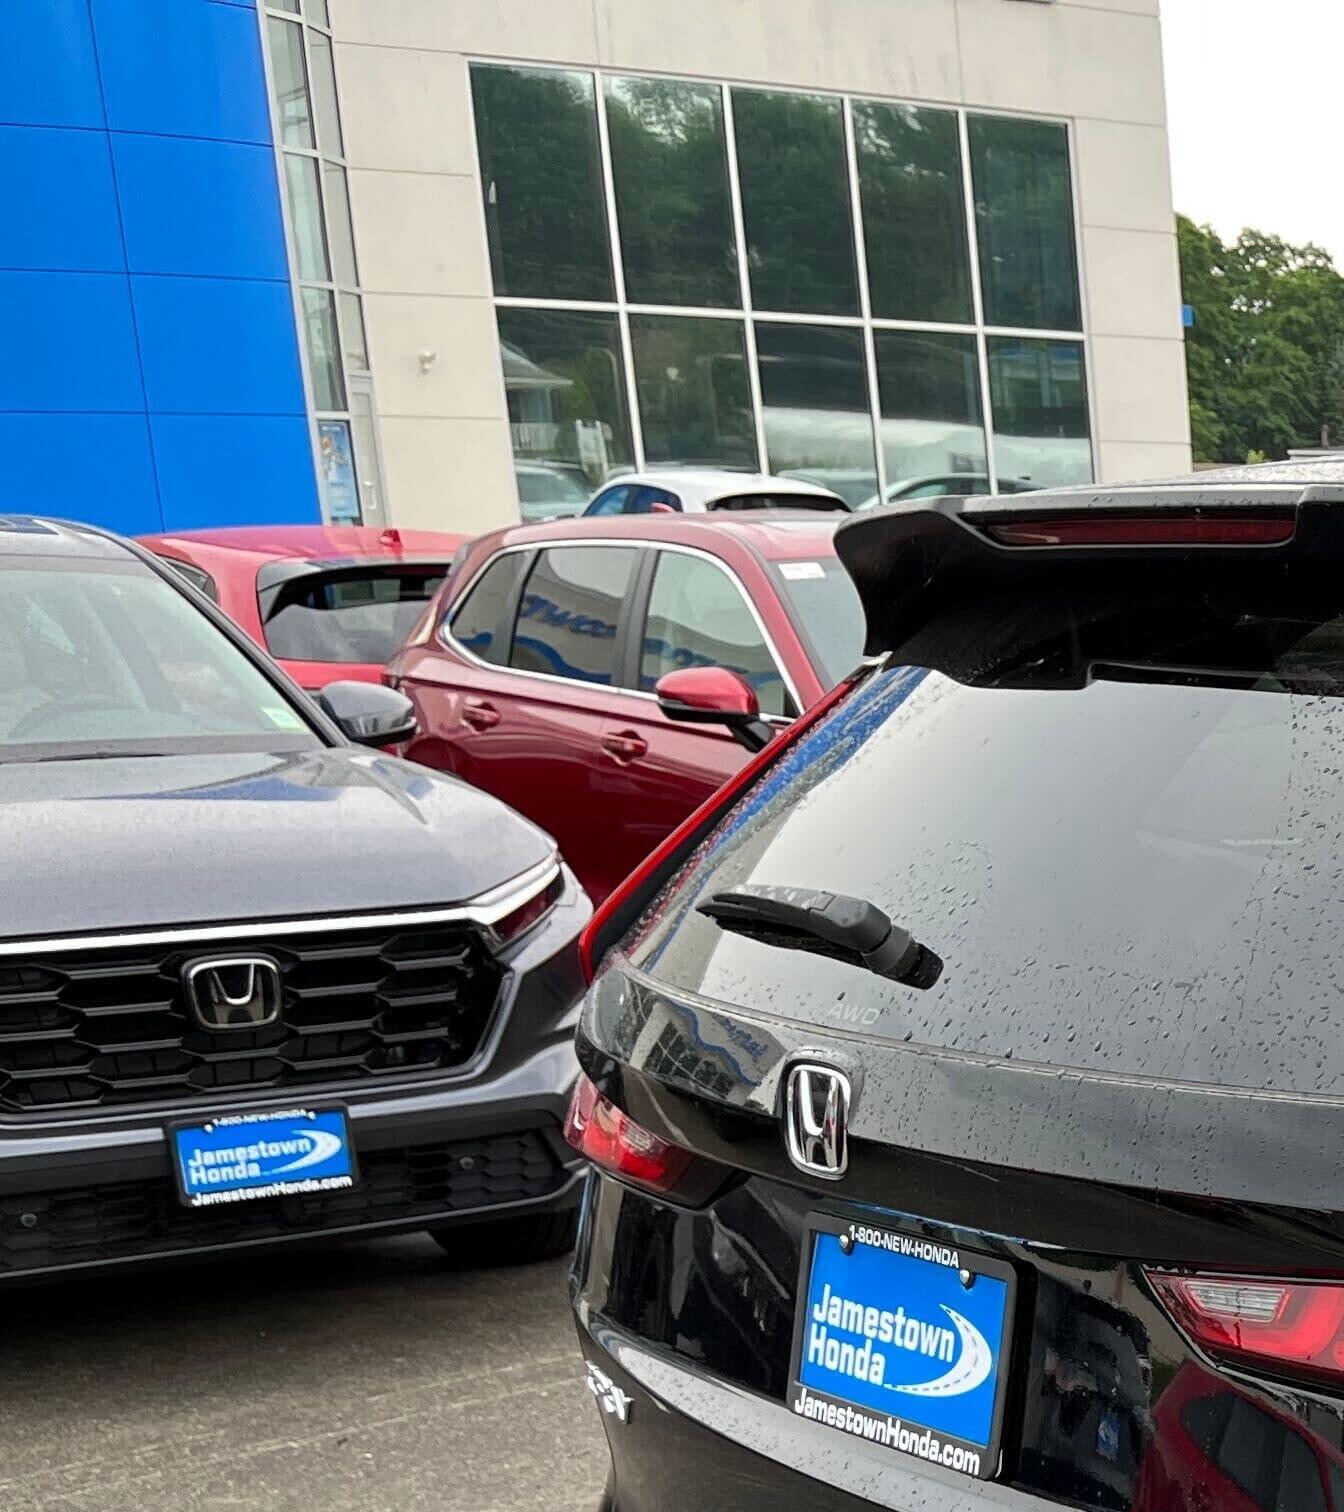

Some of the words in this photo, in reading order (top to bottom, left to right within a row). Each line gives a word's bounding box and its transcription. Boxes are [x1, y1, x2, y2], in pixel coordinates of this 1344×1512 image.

[826, 1003, 881, 1025] AWD
[188, 1138, 312, 1167] Jamestown
[188, 1162, 261, 1185] Honda
[191, 1176, 353, 1207] JamestownHonda.com
[849, 1224, 960, 1269] 1-800-NEW-HONDA
[813, 1284, 955, 1363] Jamestown
[808, 1323, 886, 1386] Honda
[794, 1388, 980, 1476] JamestownHonda.com
